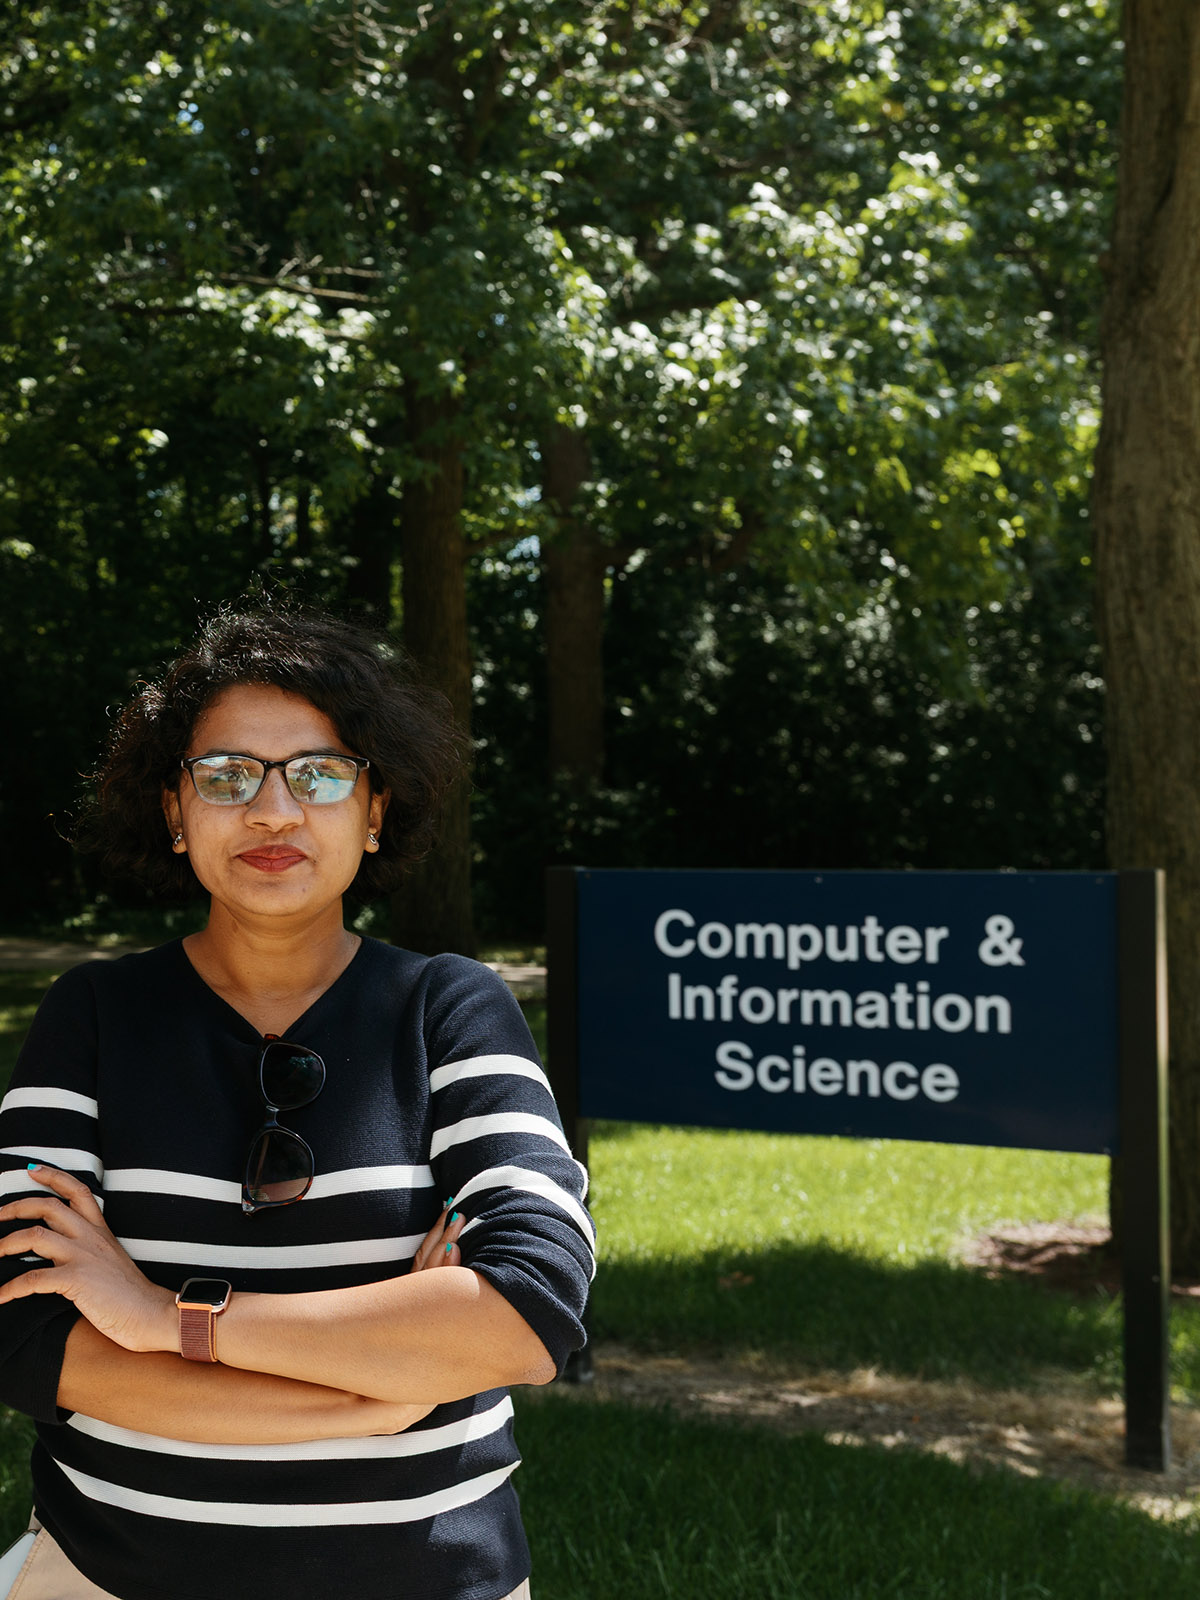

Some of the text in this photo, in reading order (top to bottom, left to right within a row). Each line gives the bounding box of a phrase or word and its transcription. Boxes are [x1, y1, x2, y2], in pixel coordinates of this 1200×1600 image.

[655, 908, 1024, 970] Computer &
[669, 973, 1011, 1033] Information
[715, 1041, 959, 1102] Science
